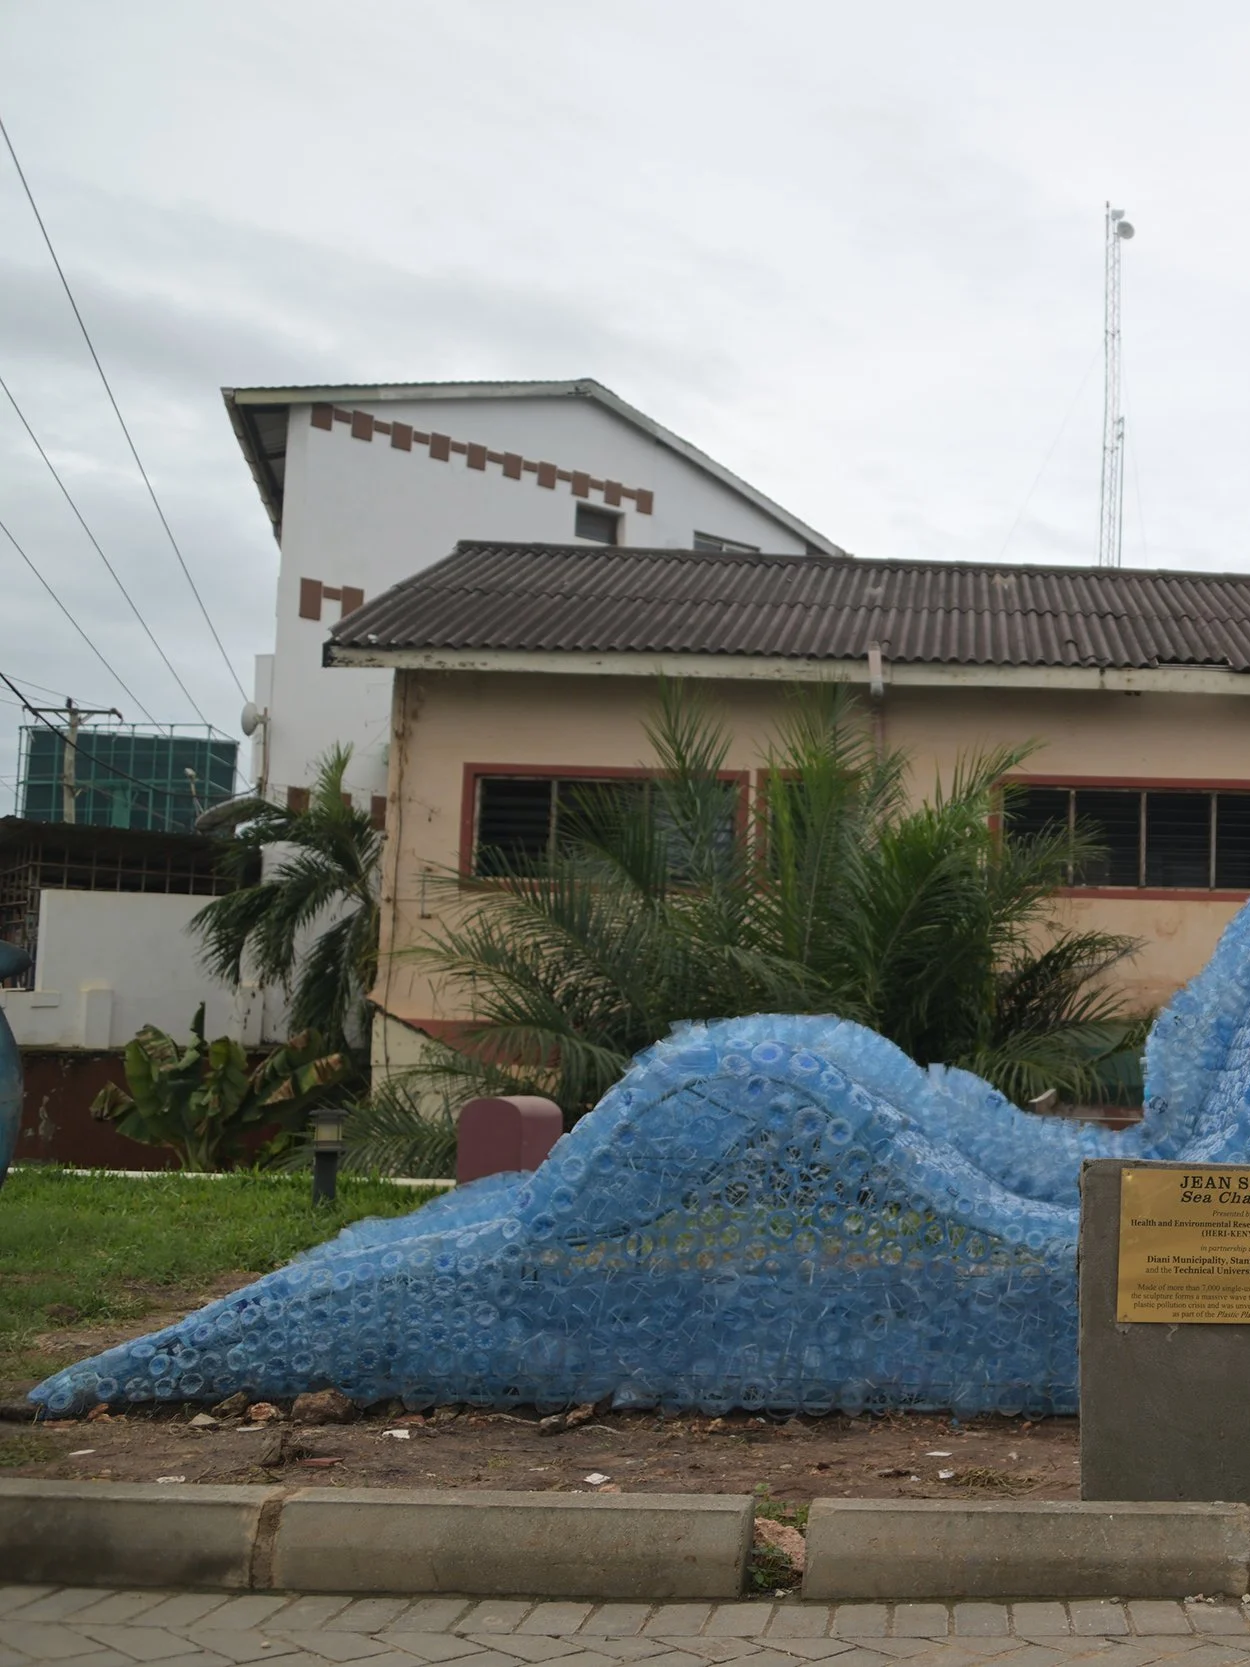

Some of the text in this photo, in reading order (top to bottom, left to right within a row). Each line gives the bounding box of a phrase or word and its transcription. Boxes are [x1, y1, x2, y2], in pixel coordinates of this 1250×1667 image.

[1180, 1176, 1232, 1189] JEAN
[1181, 1191, 1212, 1203] Sea
[1131, 1219, 1157, 1227] Health
[1175, 1220, 1231, 1228] Environmental
[1208, 1245, 1247, 1253] partnership
[1173, 1256, 1228, 1265] Municipality,
[1174, 1266, 1214, 1274] Technical
[1134, 1301, 1155, 1309] plastic
[1157, 1301, 1187, 1309] pollution
